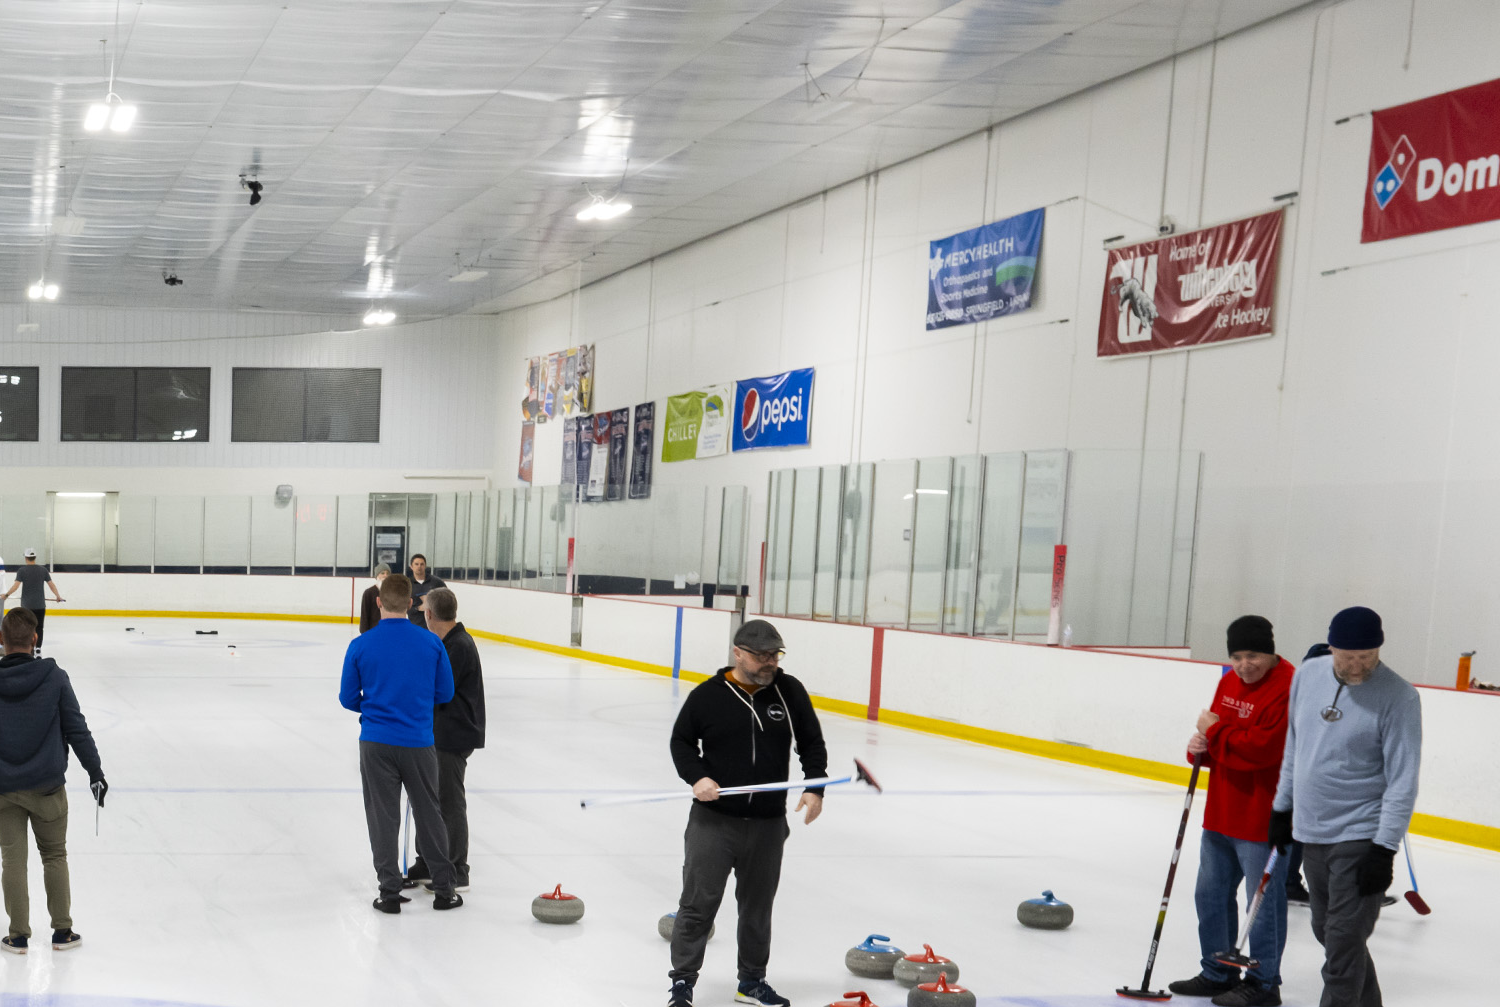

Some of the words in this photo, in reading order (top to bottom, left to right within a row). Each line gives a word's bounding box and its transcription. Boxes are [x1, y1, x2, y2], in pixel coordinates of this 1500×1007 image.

[1169, 243, 1197, 262] Home
[1215, 311, 1229, 329] Ice
[1230, 306, 1271, 327] Hockey
[760, 388, 802, 434] pepsi
